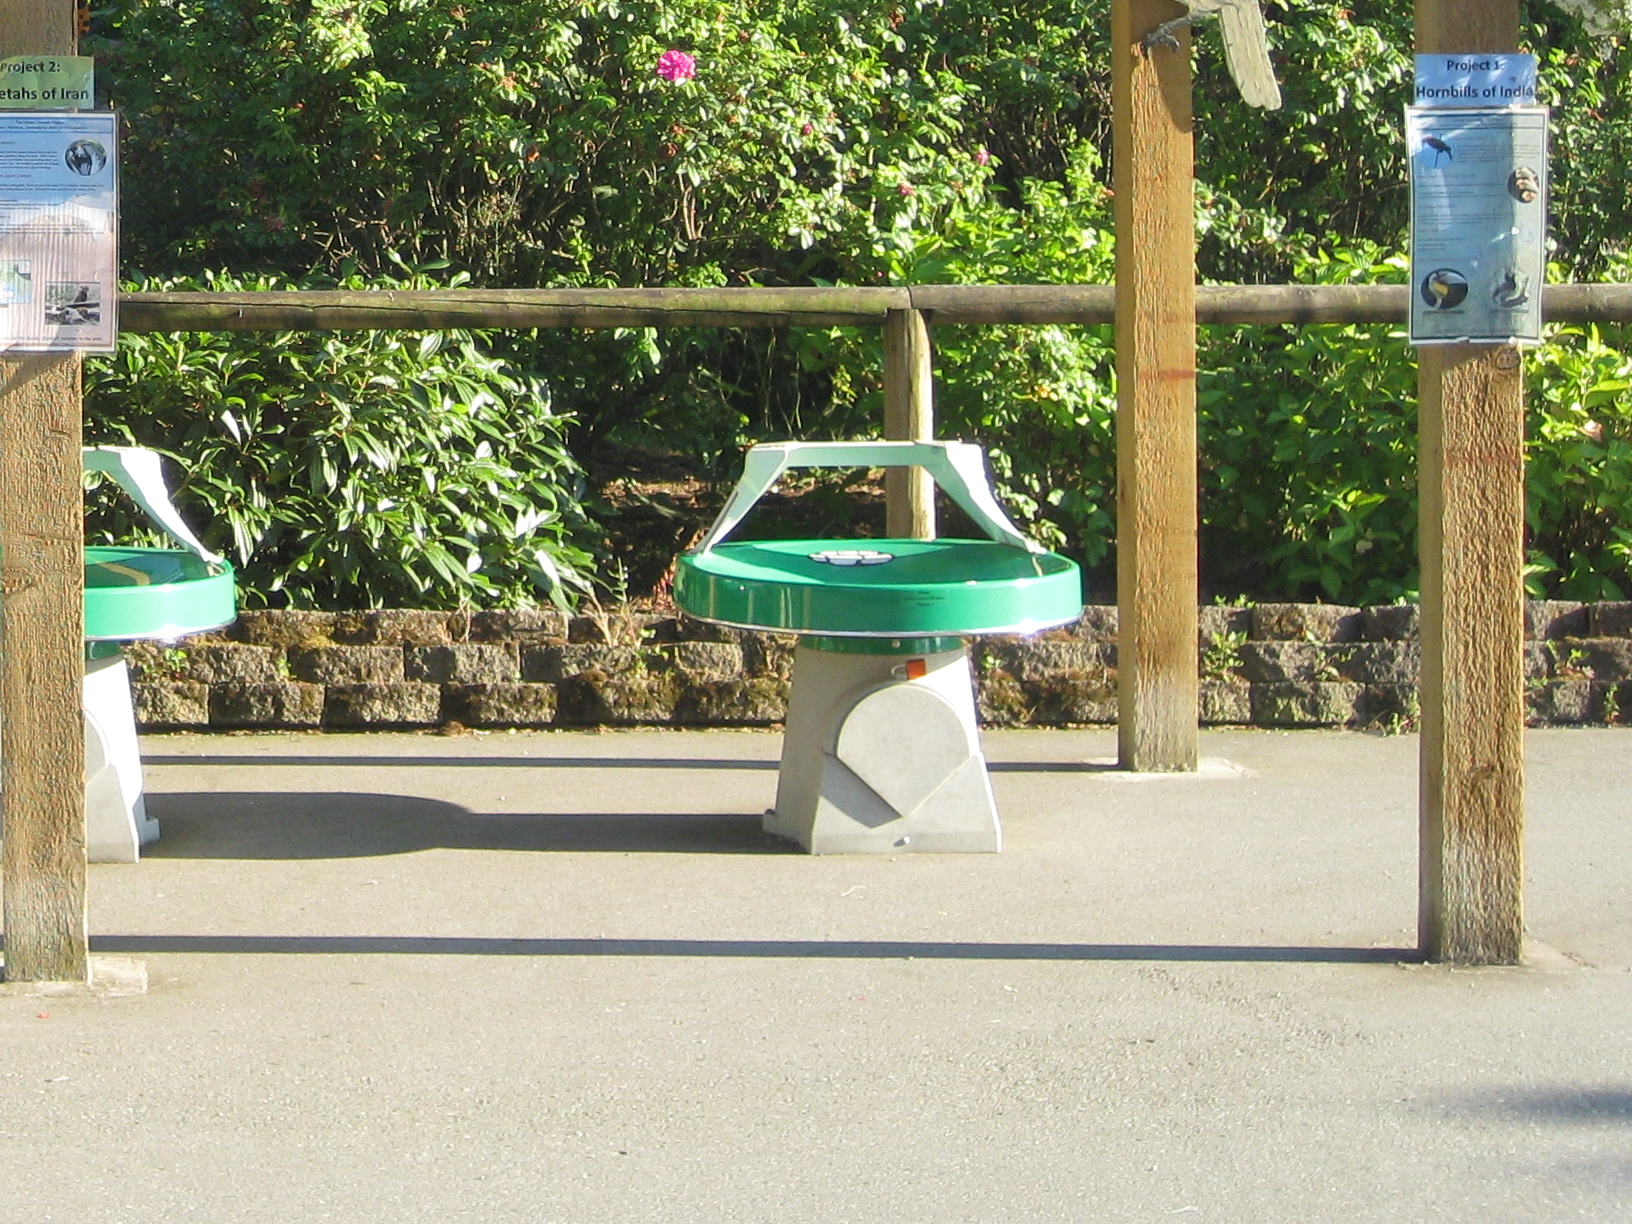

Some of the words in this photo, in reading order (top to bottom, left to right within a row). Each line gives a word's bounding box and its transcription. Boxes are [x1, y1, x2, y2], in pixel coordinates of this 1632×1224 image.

[0, 61, 45, 75] Project
[48, 61, 61, 73] 2:
[1447, 60, 1490, 72] Project
[41, 88, 57, 100] of
[61, 88, 89, 100] Iran
[1416, 86, 1478, 98] Hornbills
[1482, 86, 1495, 98] of
[1500, 86, 1533, 98] India
